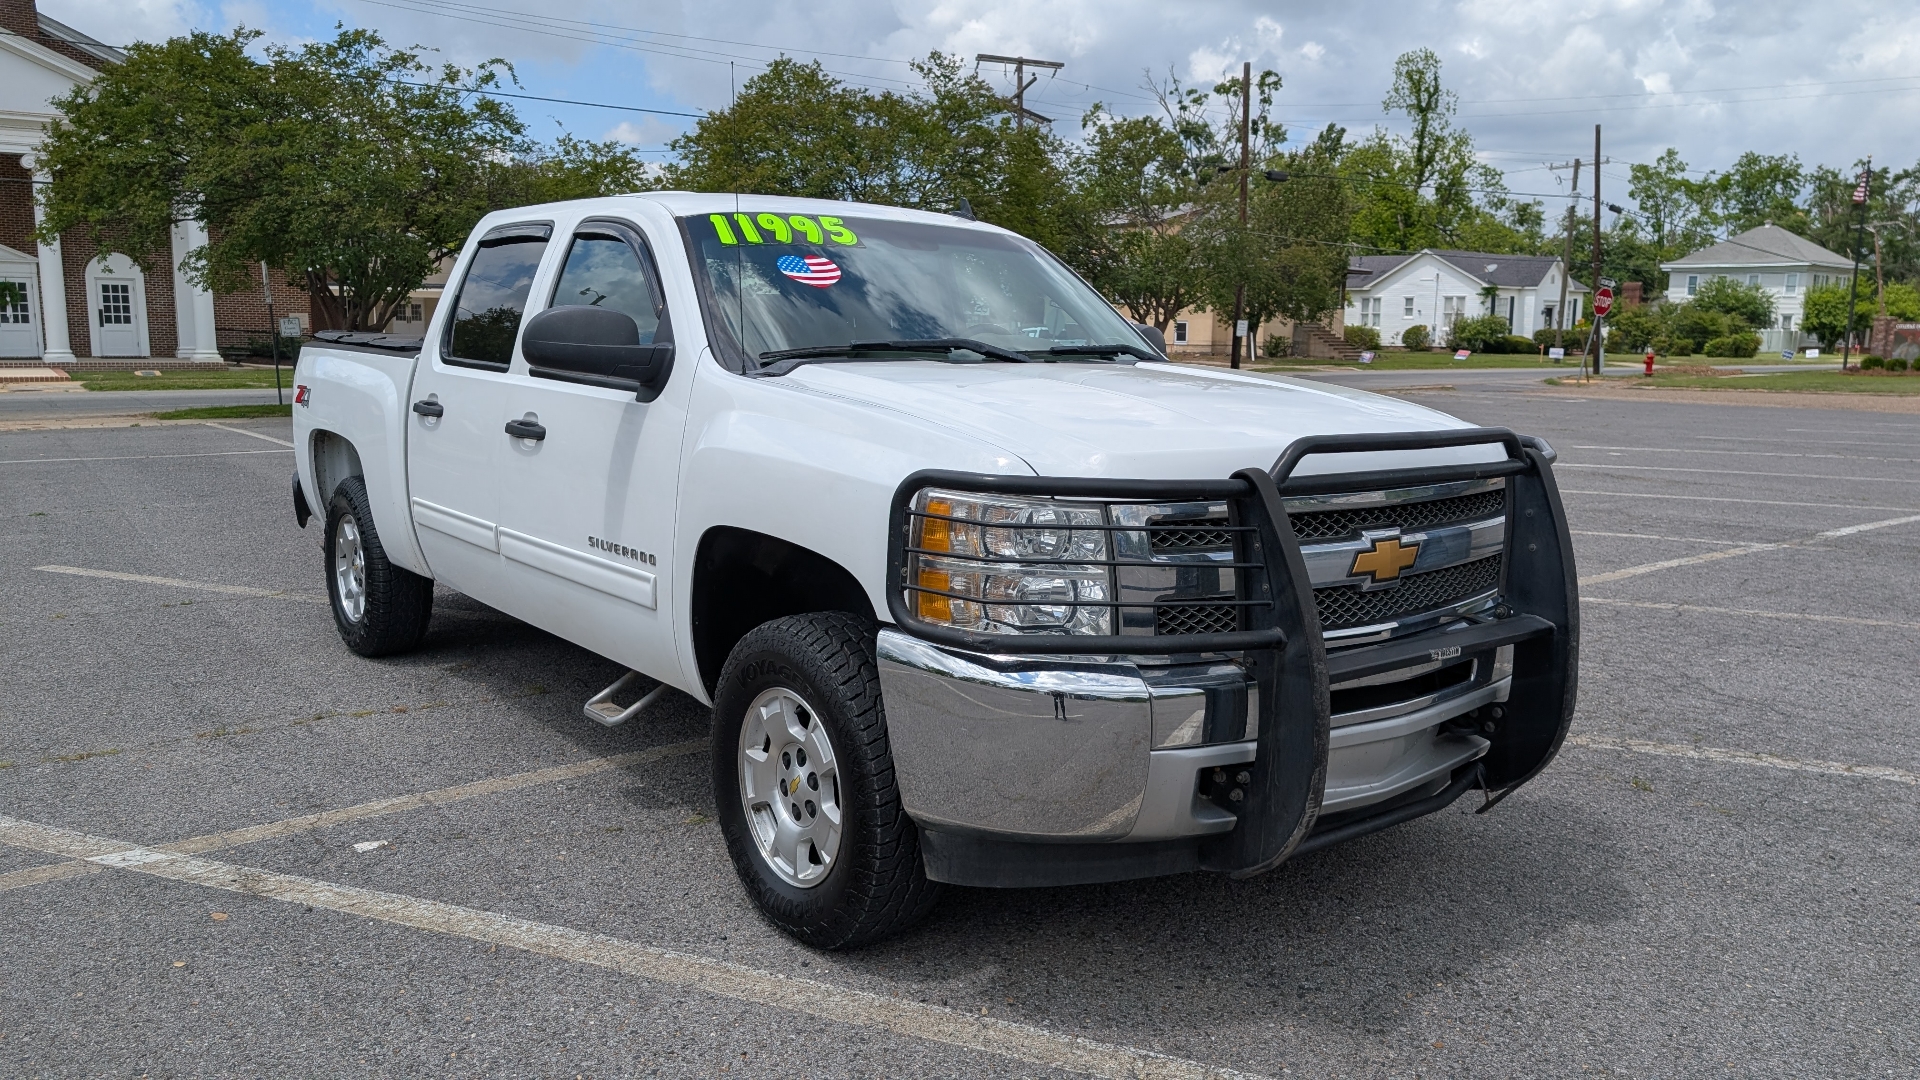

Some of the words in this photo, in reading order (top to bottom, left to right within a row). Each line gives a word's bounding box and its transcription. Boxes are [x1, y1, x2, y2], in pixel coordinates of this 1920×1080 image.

[709, 212, 859, 246] 11995
[1595, 295, 1611, 308] STOP
[588, 535, 657, 567] SILVERADO
[735, 657, 815, 699] VOYAGER
[727, 823, 824, 919] GROUNDSPEED
